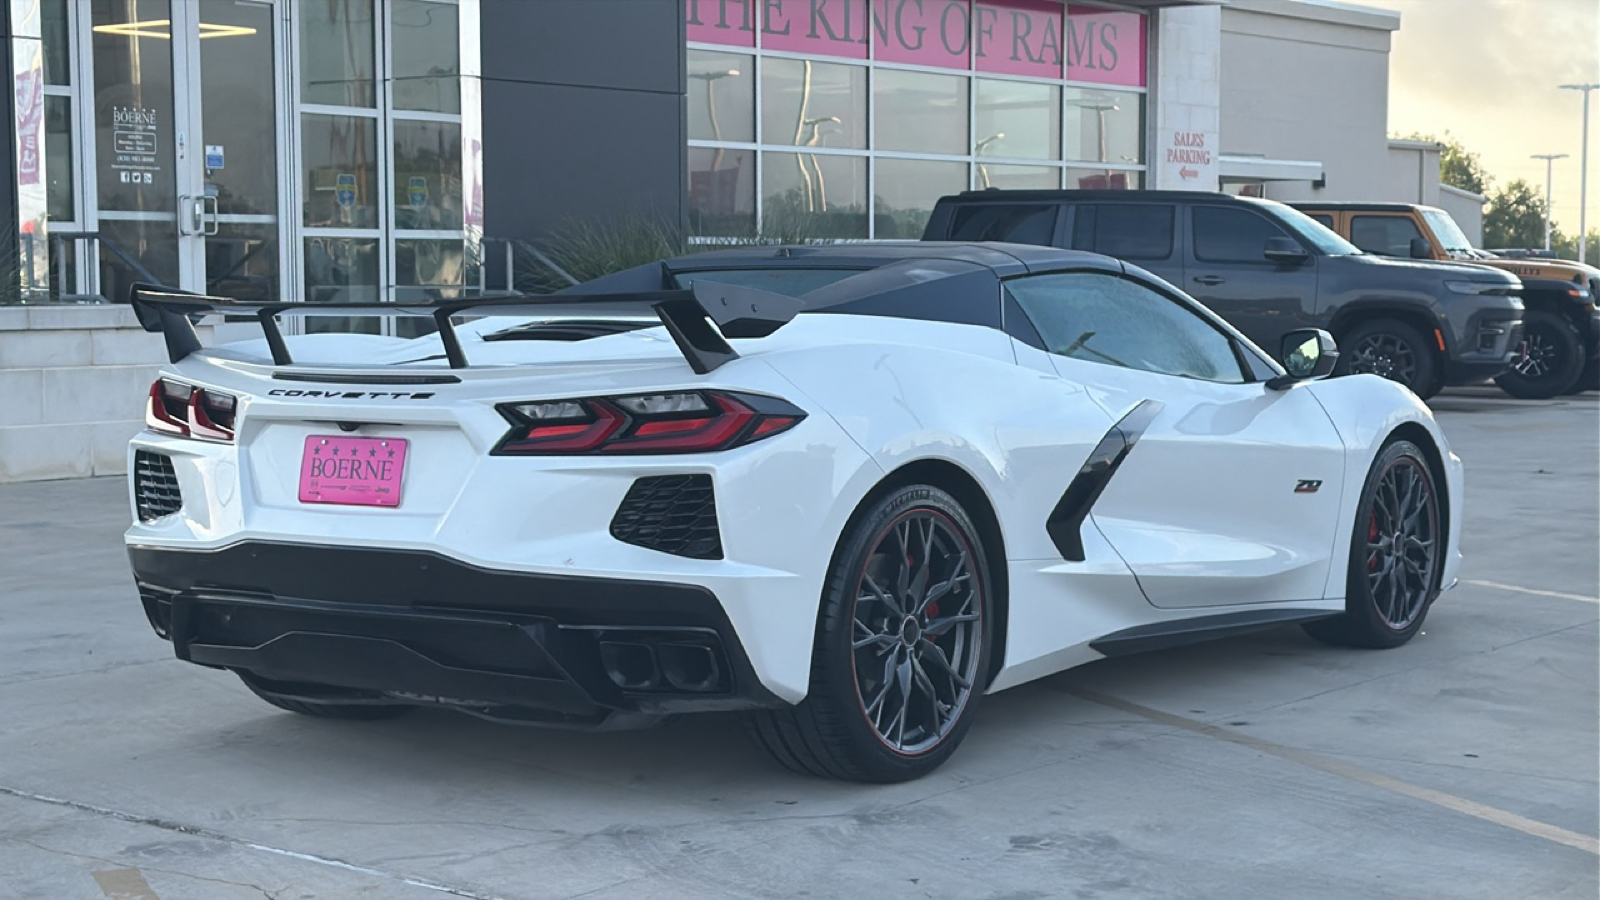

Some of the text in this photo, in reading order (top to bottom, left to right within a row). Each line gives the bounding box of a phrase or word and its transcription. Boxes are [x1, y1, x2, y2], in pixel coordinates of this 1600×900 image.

[806, 0, 927, 50] KING
[940, 2, 998, 57] OF
[1009, 10, 1119, 71] RAMS
[113, 110, 156, 124] BOERNE
[1174, 131, 1205, 147] SALES
[1167, 148, 1210, 165] PARKING
[268, 389, 436, 400] CORVETTE
[310, 457, 393, 481] BOERNE
